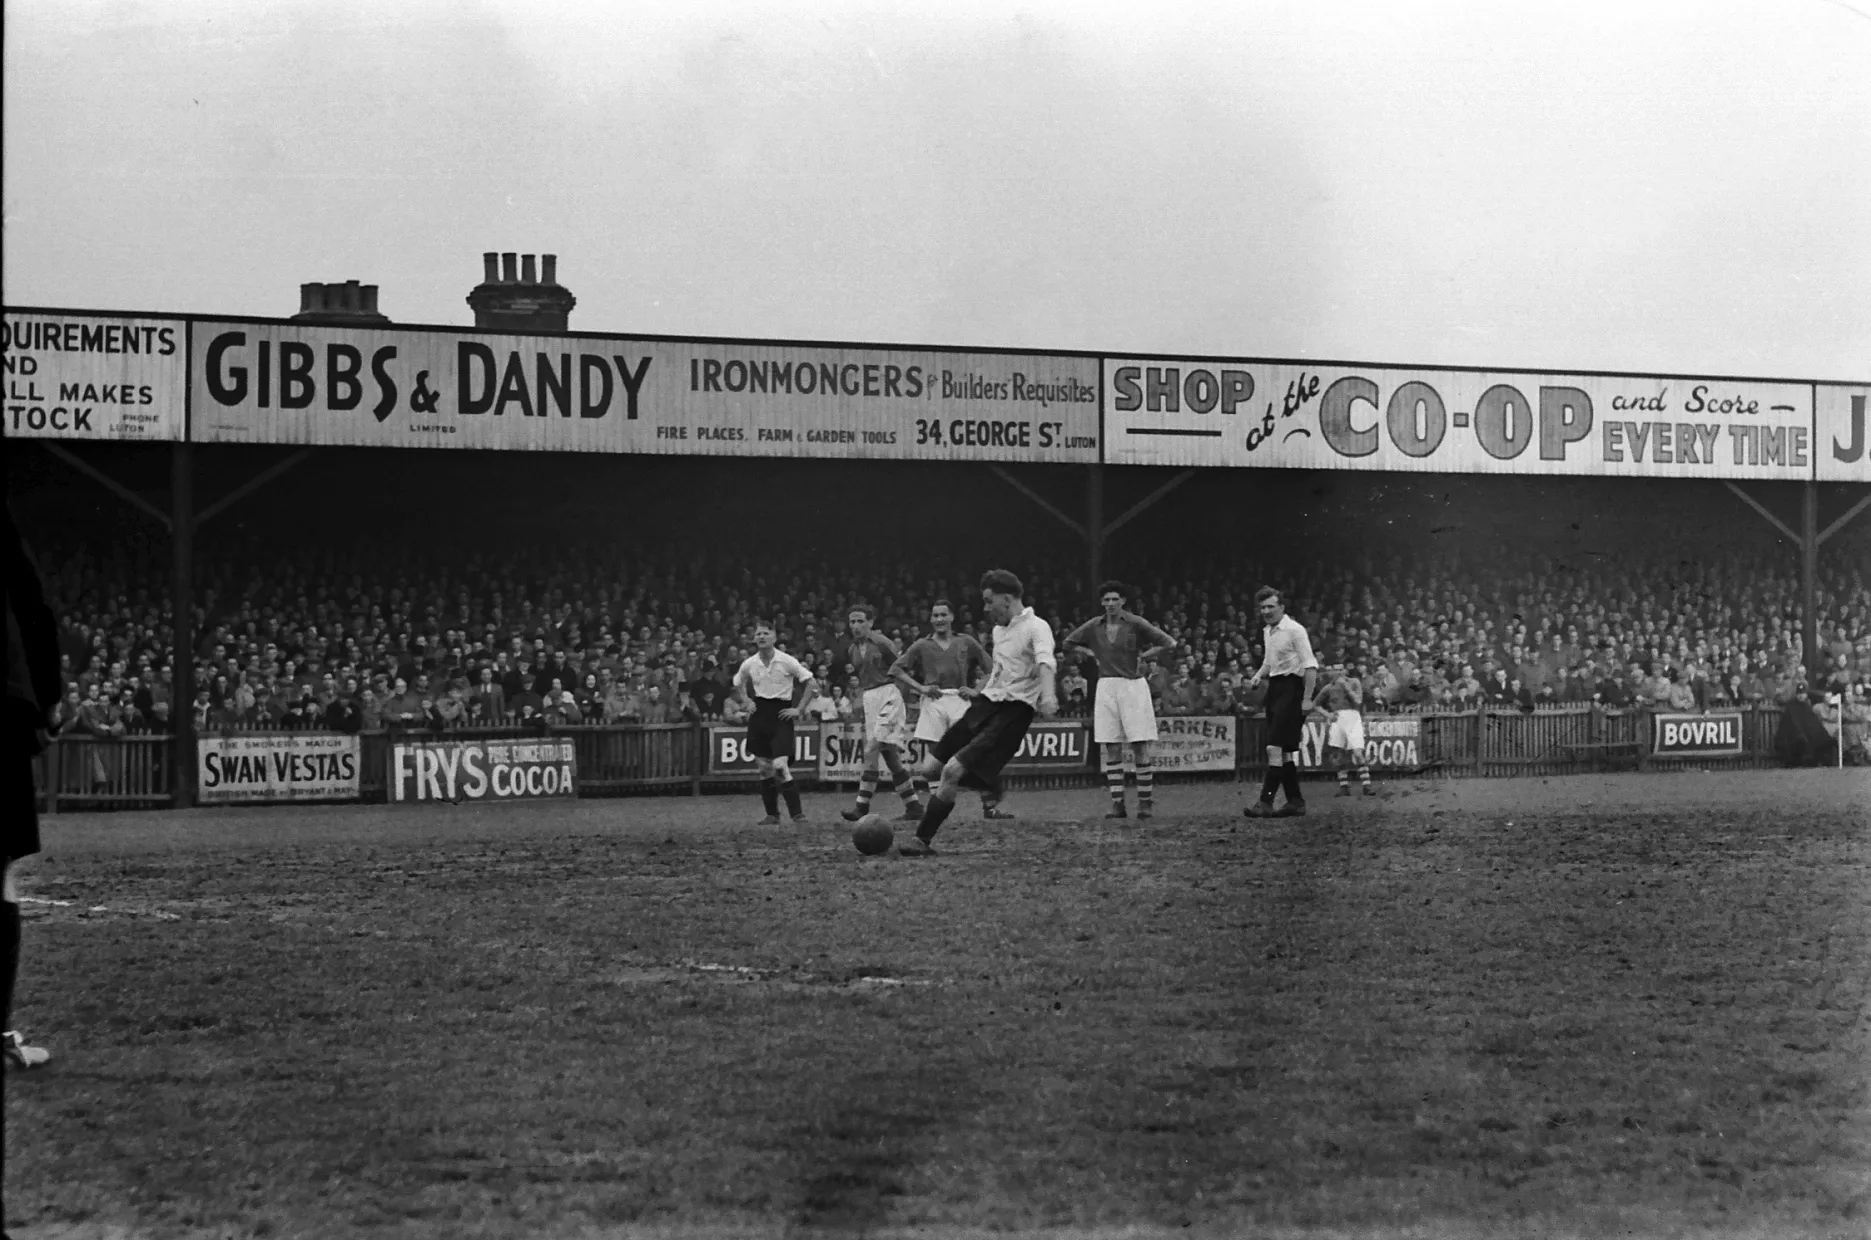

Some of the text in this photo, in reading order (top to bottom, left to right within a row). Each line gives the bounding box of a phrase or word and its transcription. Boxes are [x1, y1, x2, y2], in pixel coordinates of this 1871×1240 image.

[205, 331, 652, 423] GIBBS & DANDY
[690, 358, 923, 398] IRONMONGERS
[1012, 372, 1095, 407] Requisites
[3, 381, 153, 405] LL MAKES
[1612, 386, 1668, 412] and
[1684, 385, 1759, 415] Score
[4, 406, 92, 431] TOCK
[122, 414, 159, 423] PHONE
[1114, 366, 1593, 461] SHOP at the CO-OP
[108, 424, 144, 432] LUTON
[410, 424, 457, 433] LIMITED
[656, 426, 688, 440] FIRE
[758, 428, 793, 442] FARM
[806, 430, 855, 444] GARDEN
[862, 431, 897, 444] TOOLS
[950, 419, 1030, 448] GEORGE
[1065, 436, 1096, 449] LUTON
[1602, 420, 1807, 467] EVERY TIME
[305, 739, 342, 748] MATCH
[1157, 719, 1232, 742] ARKER.
[1664, 721, 1736, 746] BOVRIL
[721, 736, 817, 763] BOIL
[825, 734, 865, 766] SWA
[1364, 740, 1418, 766] OCOA
[205, 752, 355, 787] SWAN VESTAS
[394, 746, 488, 801] FRYS
[491, 764, 574, 797] COCOA
